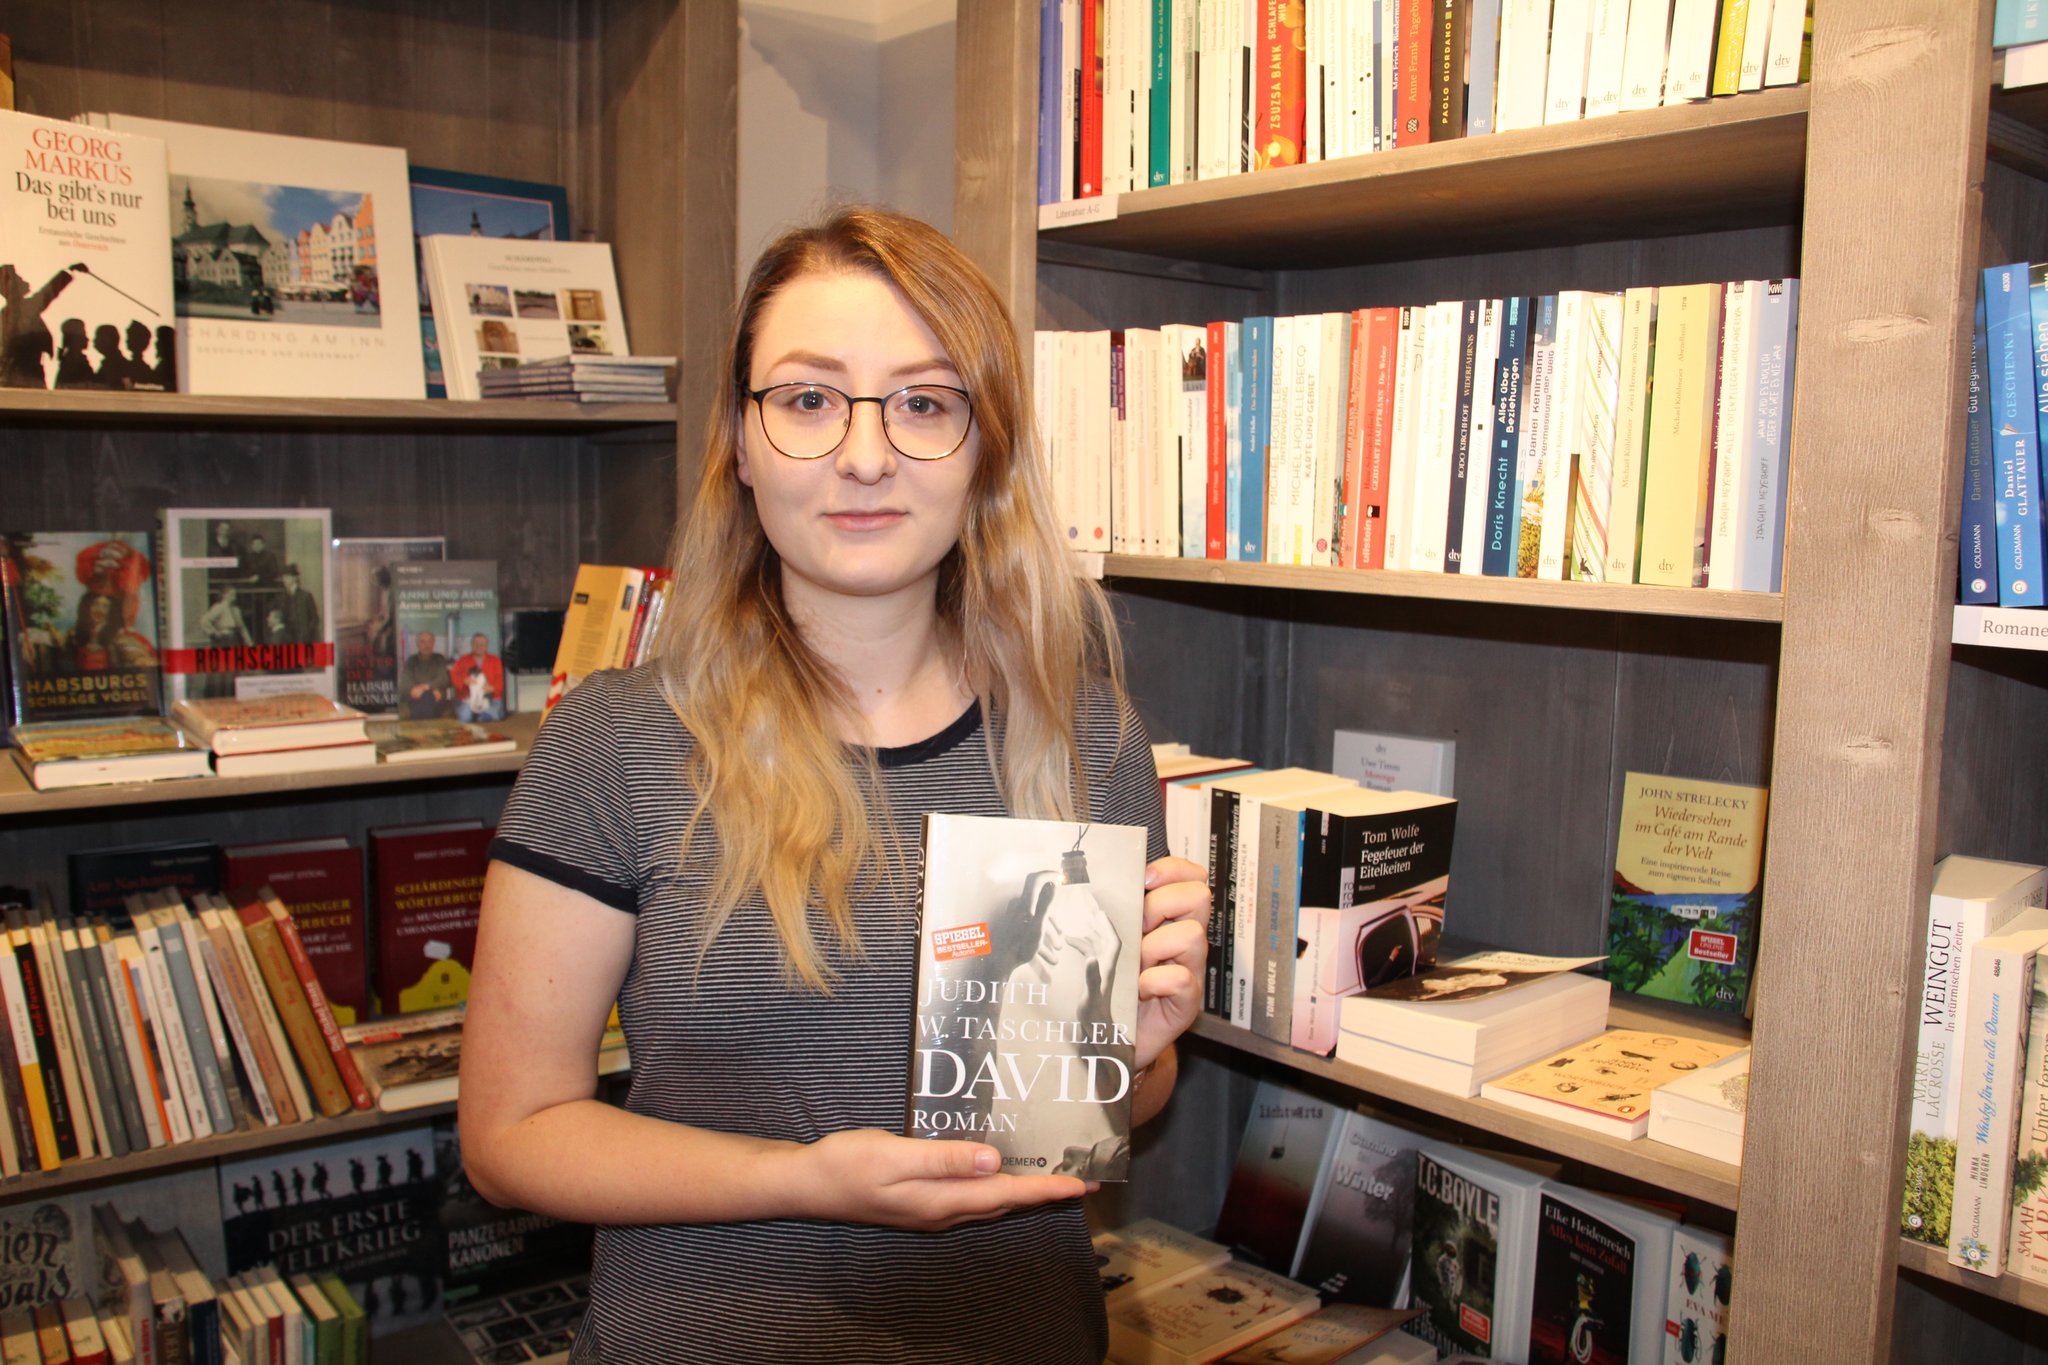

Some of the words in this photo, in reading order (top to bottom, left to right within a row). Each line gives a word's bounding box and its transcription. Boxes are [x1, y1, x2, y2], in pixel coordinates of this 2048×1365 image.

[1278, 3, 1288, 23] WIR
[1407, 41, 1419, 72] Frank
[1443, 23, 1452, 83] GIORDANO
[1742, 61, 1760, 75] dtv
[1774, 53, 1793, 68] dtv
[1408, 72, 1418, 103] Anne
[1554, 97, 1571, 111] dtv
[1631, 84, 1649, 98] dtv
[1269, 82, 1282, 130] ZSUZSA
[1441, 87, 1450, 125] PAOLO
[1473, 115, 1486, 128] dtv
[32, 128, 123, 162] GEORG
[25, 149, 133, 187] MARKUS
[15, 171, 53, 197] Das
[58, 180, 106, 205] gibt's
[110, 191, 143, 209] nur
[46, 198, 75, 222] bei
[82, 208, 117, 228] uns
[1055, 204, 1086, 220] Literatur
[311, 331, 337, 344] AM
[351, 333, 386, 348] INN
[1632, 325, 1641, 351] Strand
[1676, 323, 1687, 362] Abendland
[2035, 321, 2048, 371] sieben
[1379, 345, 1388, 371] Weber
[1463, 333, 1475, 397] WIDERFAHRNIS
[2007, 330, 2017, 419] GESCHENKT
[1307, 373, 1316, 414] GEBIET
[1378, 371, 1386, 385] Die
[1532, 349, 1544, 414] Kehlmann
[1628, 363, 1637, 394] Herren
[2038, 375, 2048, 413] Alle
[1272, 346, 1284, 450] HOUELLEBECQ
[1294, 345, 1306, 450] HOUELLEBECQ
[1498, 396, 1507, 425] Alles
[1505, 357, 1519, 434] Beziehungen
[1627, 395, 1635, 413] Zwei
[1968, 393, 1978, 414] Gut
[1279, 386, 1289, 466] UNTERWERFUNG
[1306, 416, 1314, 439] UND
[1373, 389, 1385, 446] HAUPTMANN
[1458, 403, 1469, 452] KIRCHHOFF
[1672, 407, 1681, 435] Michael
[1528, 417, 1538, 458] Daniel
[1971, 418, 1982, 461] Glattauer
[1304, 443, 1312, 479] KARTE
[1371, 447, 1382, 491] GERHART
[1457, 453, 1466, 479] BODO
[1621, 459, 1631, 488] Michael
[2017, 439, 2028, 516] GLATTAUER
[1270, 452, 1279, 507] MICHEL
[1291, 452, 1301, 507] MICHEL
[1492, 456, 1507, 509] Knecht
[1971, 462, 1981, 501] Daniel
[2004, 459, 2014, 498] Daniel
[1362, 519, 1373, 564] ullstein
[1491, 514, 1504, 551] Doris
[1974, 524, 1982, 570] GOLDMANN
[2015, 524, 2023, 570] GOLDMANN
[1543, 554, 1558, 568] dtv
[1611, 559, 1627, 571] dtv
[1658, 558, 1675, 573] dtv
[399, 589, 431, 600] ANNI
[433, 589, 458, 600] UND
[461, 589, 494, 600] ALOIS
[400, 601, 422, 611] Arm
[423, 601, 443, 610] sind
[445, 601, 460, 610] wir
[462, 600, 486, 609] nicht
[1983, 620, 2048, 639] Romane
[195, 643, 315, 671] ROTHSCHILD
[26, 673, 148, 695] HABSBURGS
[101, 689, 148, 705] VÖGEL
[1638, 787, 1672, 801] JOHN
[1675, 791, 1750, 810] STRELECKY
[1653, 805, 1732, 828] Wiedersehen
[1229, 805, 1240, 883] Deutschlehrerin
[1362, 831, 1387, 845] Tom
[1391, 824, 1420, 841] Wolfe
[1635, 820, 1651, 835] im
[1653, 822, 1682, 840] Café
[1683, 830, 1704, 843] am
[1706, 829, 1747, 848] Rande
[1240, 843, 1248, 888] TASCHLER
[1361, 846, 1409, 866] Fegefeuer
[1410, 842, 1425, 855] der
[1641, 856, 1658, 867] Eine
[1710, 867, 1732, 879] Reise
[1663, 841, 1683, 856] der
[1684, 843, 1714, 861] Welt
[1360, 861, 1411, 879] Eitelkeiten
[1648, 869, 1664, 879] zum
[1666, 871, 1696, 884] eigenen
[1697, 876, 1722, 888] Selbst
[1228, 886, 1236, 902] Die
[416, 908, 468, 923] MUNDART
[1238, 906, 1246, 939] JUDITH
[935, 926, 986, 945] SPIEGEL
[1951, 921, 1965, 954] Zeiten
[952, 949, 976, 958] Autorin
[1694, 947, 1729, 959] Bestseller
[1266, 960, 1276, 994] WOLFE
[1923, 919, 1953, 1028] WEINGUT
[1946, 957, 1962, 1022] stürmischen
[919, 979, 1049, 1007] JUDITH
[1265, 997, 1275, 1018] TOM
[1716, 986, 1736, 1000] dtv
[916, 1014, 950, 1039] W.
[957, 1016, 1133, 1047] TASCHLER
[1983, 992, 2001, 1037] Damen
[1981, 1039, 1996, 1058] alte
[2034, 1032, 2048, 1092] fernen
[912, 1048, 1132, 1104] DAVID
[1911, 1052, 1928, 1105] MARIE
[1926, 1041, 1946, 1119] LACROSSE
[1979, 1059, 1995, 1084] drei
[1977, 1085, 1995, 1104] für
[912, 1109, 1019, 1133] ROMAN
[1974, 1103, 1996, 1147] Whisky
[2031, 1094, 2048, 1145] Unter
[1349, 1133, 1398, 1158] Camino
[1336, 1165, 1395, 1201] Winter
[1969, 1157, 1979, 1181] MINNA
[1977, 1154, 1990, 1191] LINDGREN
[1418, 1153, 1440, 1199] T.C.
[1441, 1170, 1499, 1230] BOYLE
[268, 1223, 323, 1253] DER
[331, 1202, 412, 1241] ERSTE
[1544, 1203, 1569, 1225] Elke
[1571, 1216, 1631, 1260] Heidenreich
[1971, 1196, 1982, 1240] GOLDMANN
[2016, 1206, 2033, 1258] SARAH
[284, 1220, 422, 1273] ELTKRIEG
[449, 1236, 525, 1269] KANONEN
